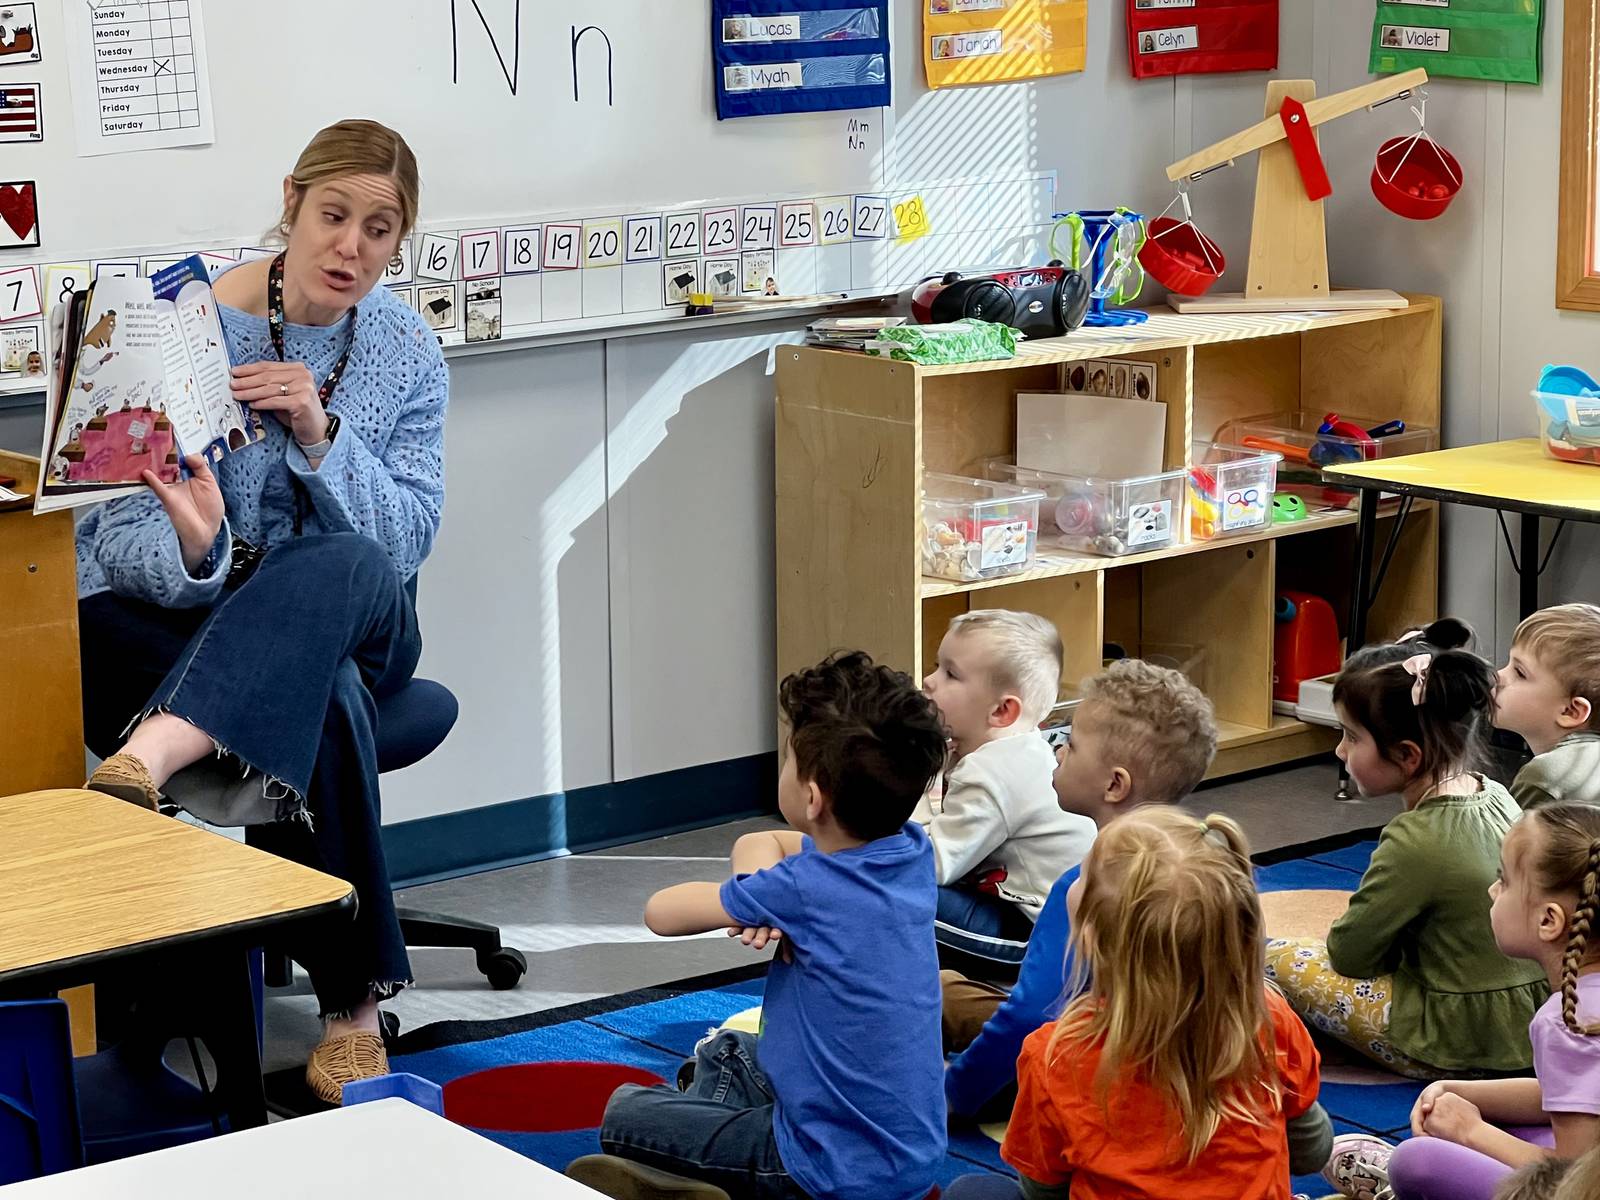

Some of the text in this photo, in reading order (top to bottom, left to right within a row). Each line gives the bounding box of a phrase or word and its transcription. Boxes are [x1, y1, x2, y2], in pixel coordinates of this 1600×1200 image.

[94, 11, 125, 19] Sunday
[96, 29, 130, 38] Monday
[749, 23, 793, 37] Lucas
[1158, 32, 1185, 48] Celyn
[1405, 30, 1441, 47] Violet
[97, 48, 133, 56] Tuesday
[451, 0, 612, 106] N n
[99, 65, 148, 75] Wednesday
[750, 67, 790, 88] Myah
[101, 84, 140, 94] Thursday
[102, 104, 131, 112] Friday
[104, 121, 143, 131] Saturday
[427, 242, 447, 271] 16
[472, 240, 491, 269] 17
[513, 238, 532, 265] 18
[551, 233, 572, 260] 19
[588, 230, 619, 259] 20
[634, 225, 654, 252] 21
[669, 221, 696, 250] 22
[707, 218, 735, 248] 23
[744, 216, 772, 242] 24
[785, 213, 812, 239] 25
[823, 208, 849, 236] 26
[858, 205, 885, 231] 27
[896, 201, 920, 229] 28
[6, 280, 23, 312] 7
